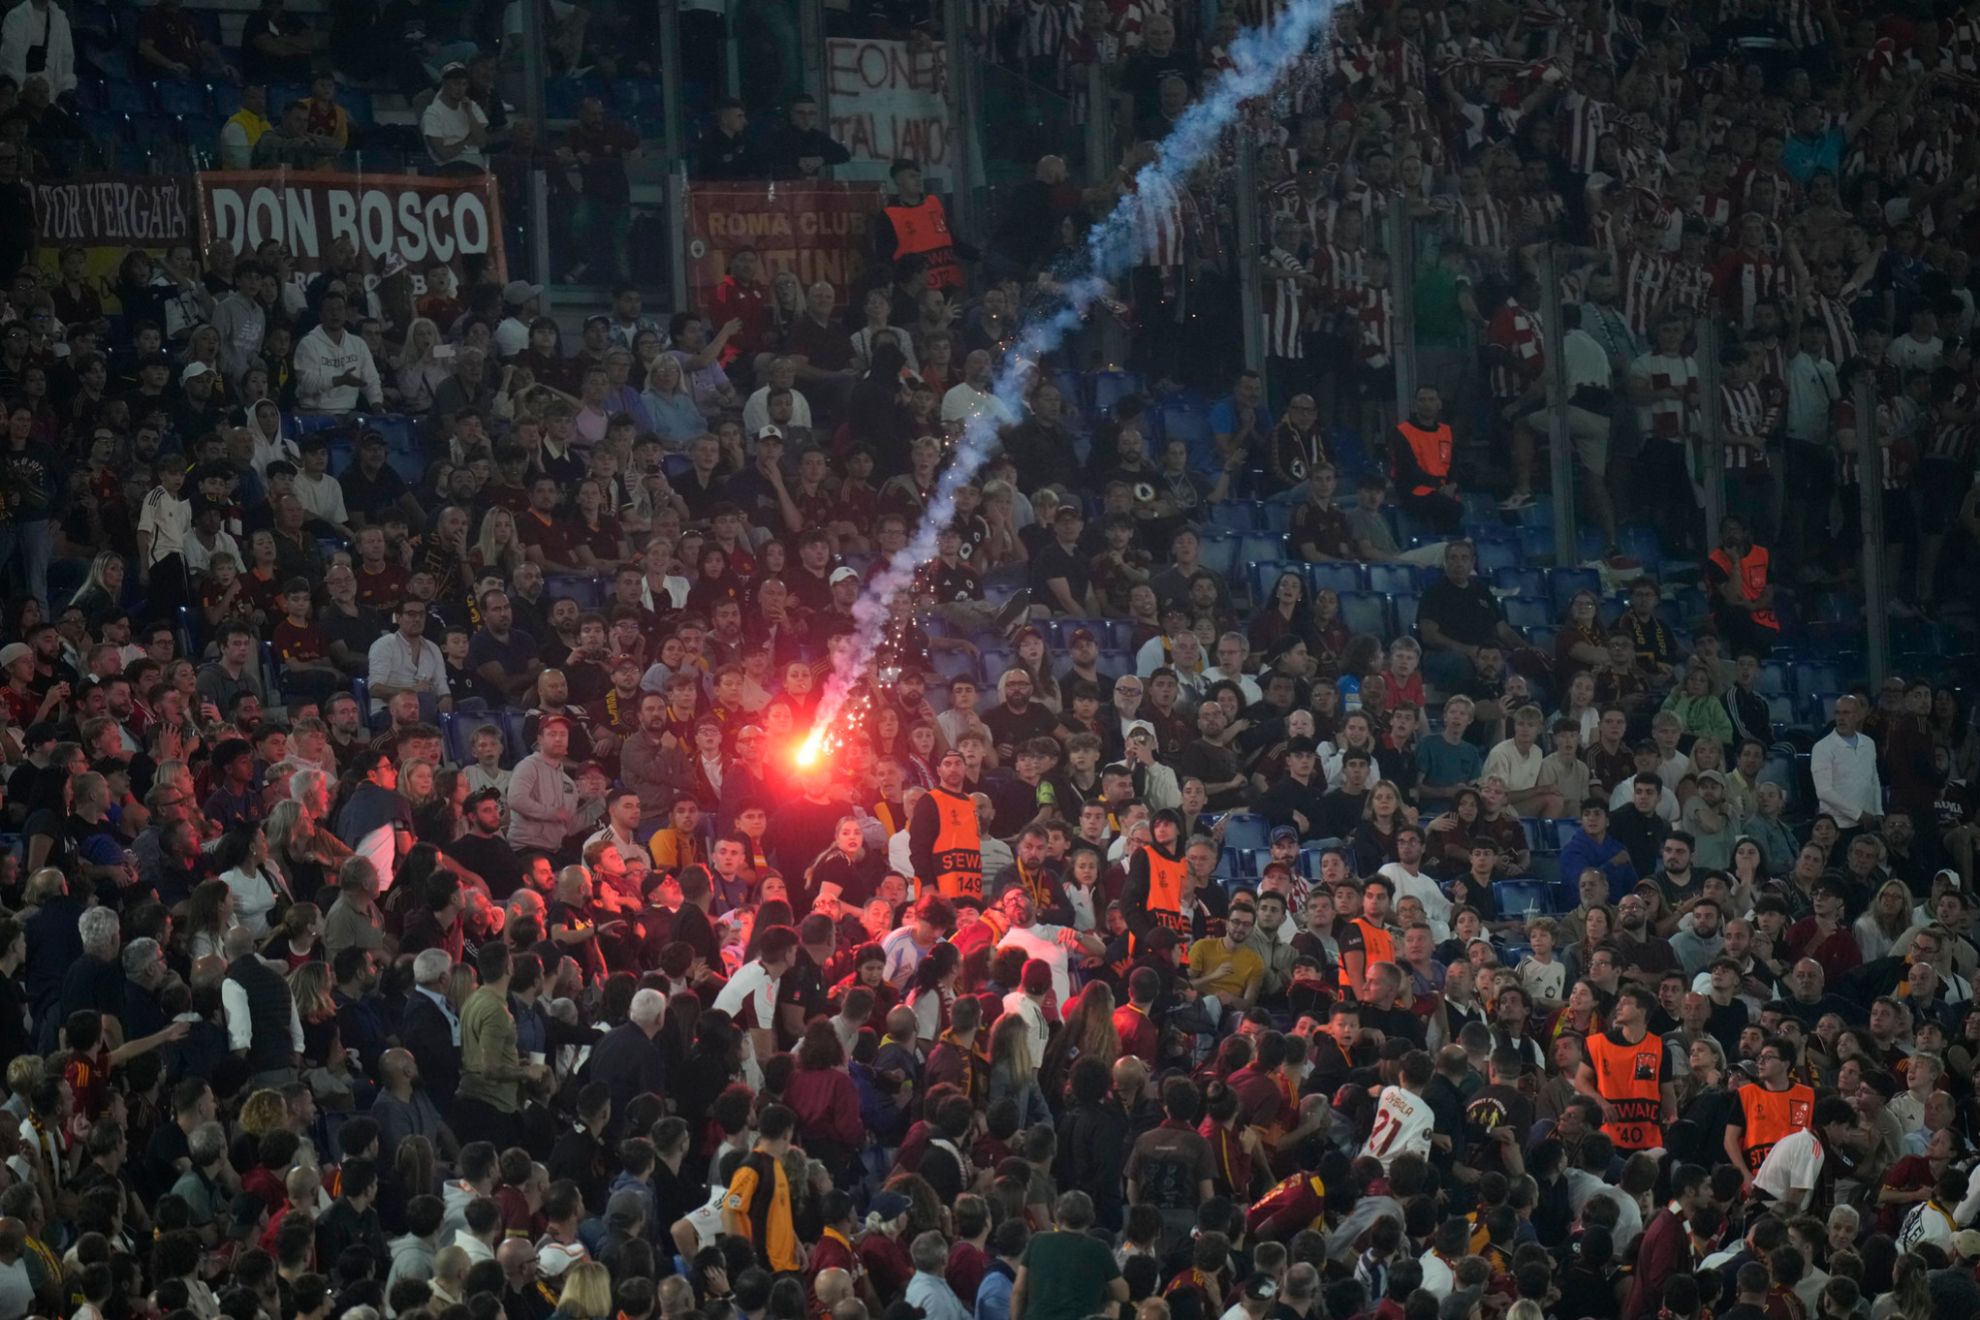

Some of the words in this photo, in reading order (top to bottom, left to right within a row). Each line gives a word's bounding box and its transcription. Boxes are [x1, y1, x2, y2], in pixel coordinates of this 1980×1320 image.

[38, 184, 84, 239] TOR
[84, 181, 187, 239] VERGATA
[212, 187, 320, 258] DON
[328, 189, 488, 263] BOSCO
[708, 212, 793, 236] ROMA
[800, 211, 868, 236] CLUB
[957, 876, 982, 893] 149
[1369, 1108, 1403, 1158] 21
